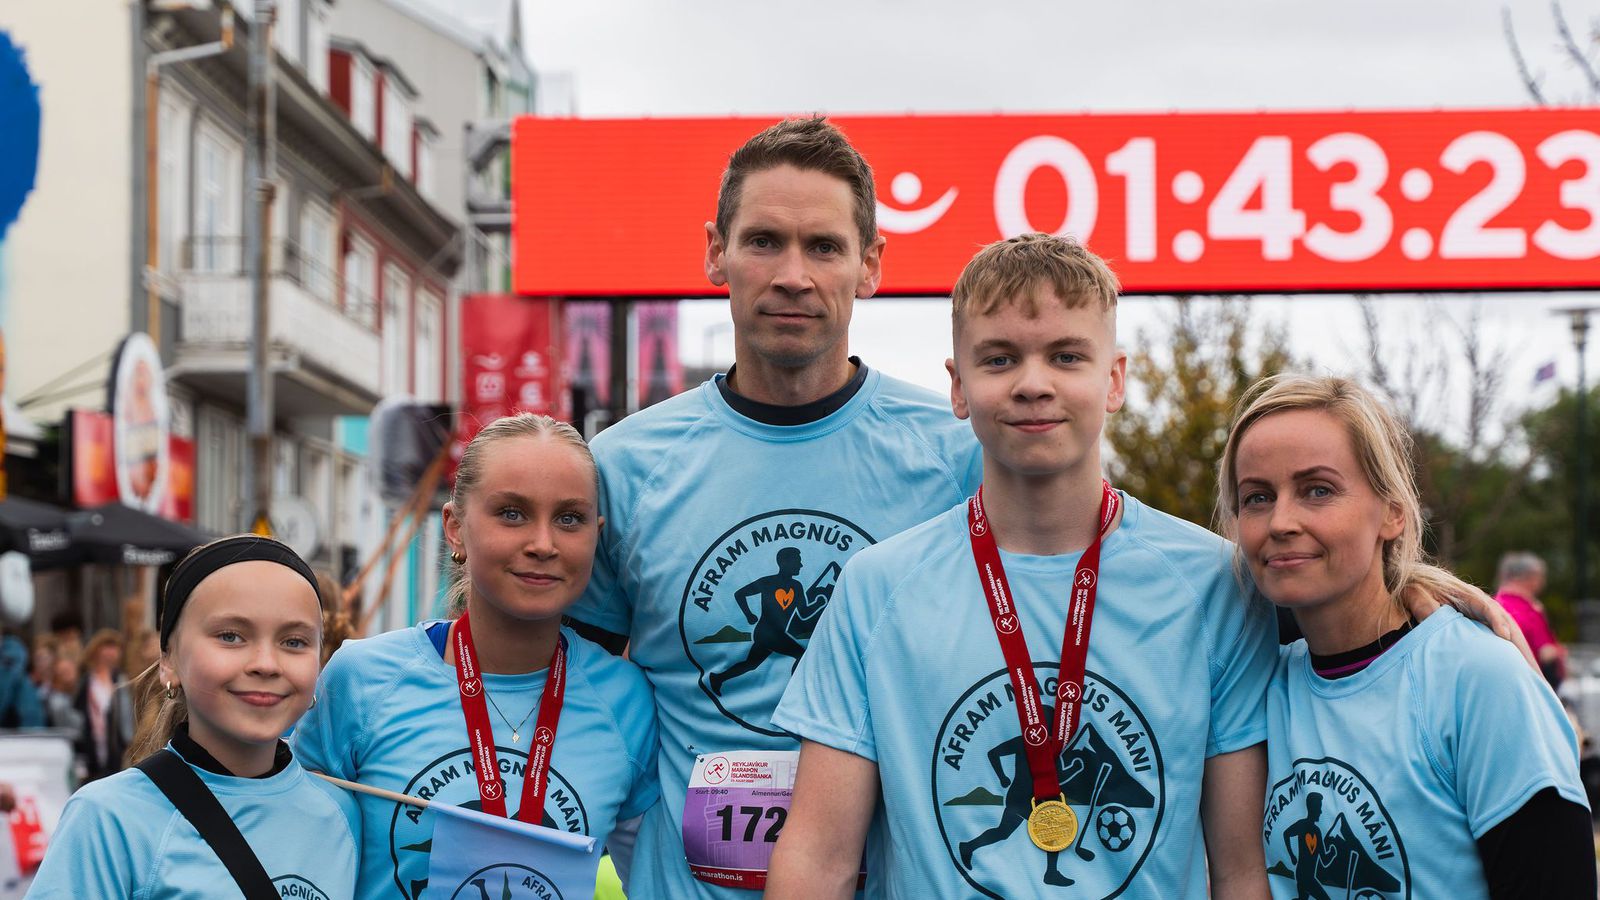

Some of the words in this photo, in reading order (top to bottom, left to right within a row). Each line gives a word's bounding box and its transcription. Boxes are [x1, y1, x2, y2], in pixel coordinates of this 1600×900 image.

[992, 130, 1600, 263] 01:43:23
[693, 538, 749, 613] ÁFRAM
[750, 521, 853, 552] MAGNÚS
[943, 691, 1003, 771] ÁFRAM
[1107, 709, 1152, 773] MÁNI
[405, 764, 461, 825] ÁRAM
[550, 788, 581, 833] MÁN
[1355, 800, 1395, 861] MÁNI
[521, 875, 552, 900] ÁFRA
[700, 871, 744, 881] marathon.is
